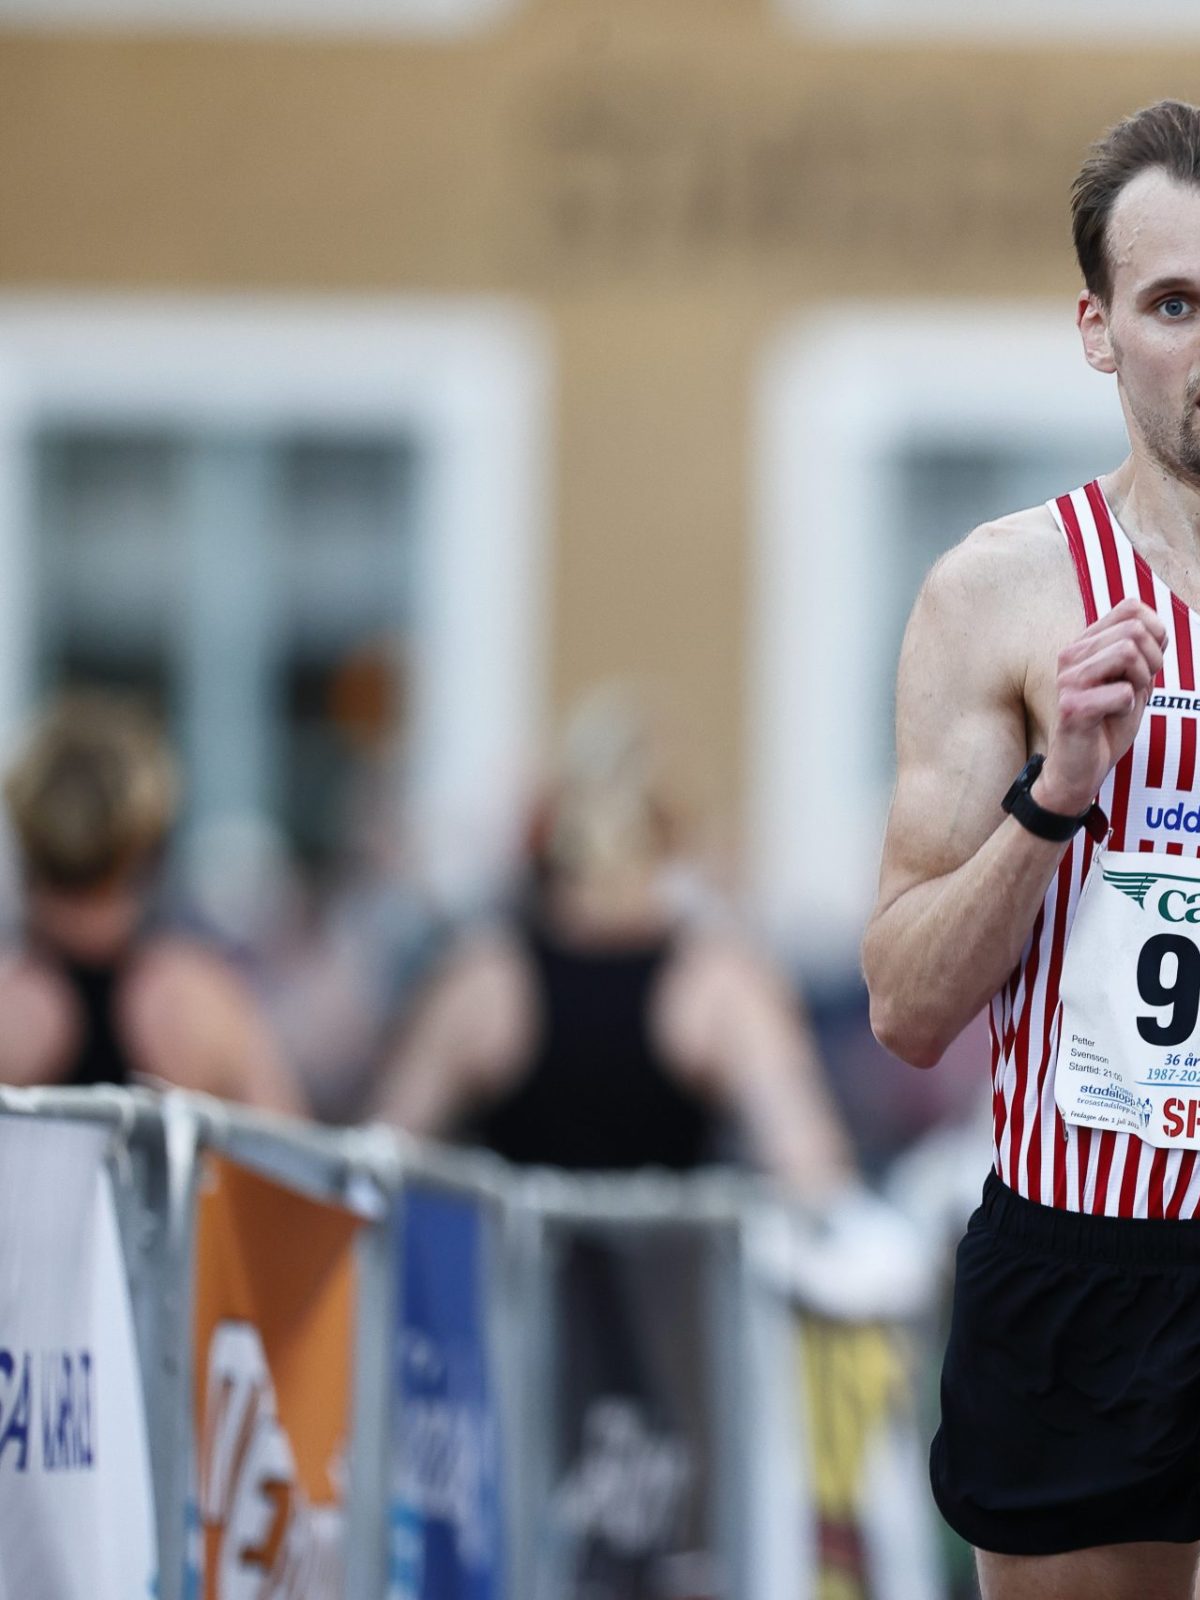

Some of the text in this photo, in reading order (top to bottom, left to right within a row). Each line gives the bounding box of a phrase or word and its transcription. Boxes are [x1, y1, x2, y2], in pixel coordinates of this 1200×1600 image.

[1071, 1034, 1096, 1047] Petter
[1070, 1048, 1109, 1064] Svensson
[1165, 1052, 1200, 1067] 36 år
[1068, 1062, 1101, 1076] Starttid:
[1080, 1084, 1136, 1107] stadslopp
